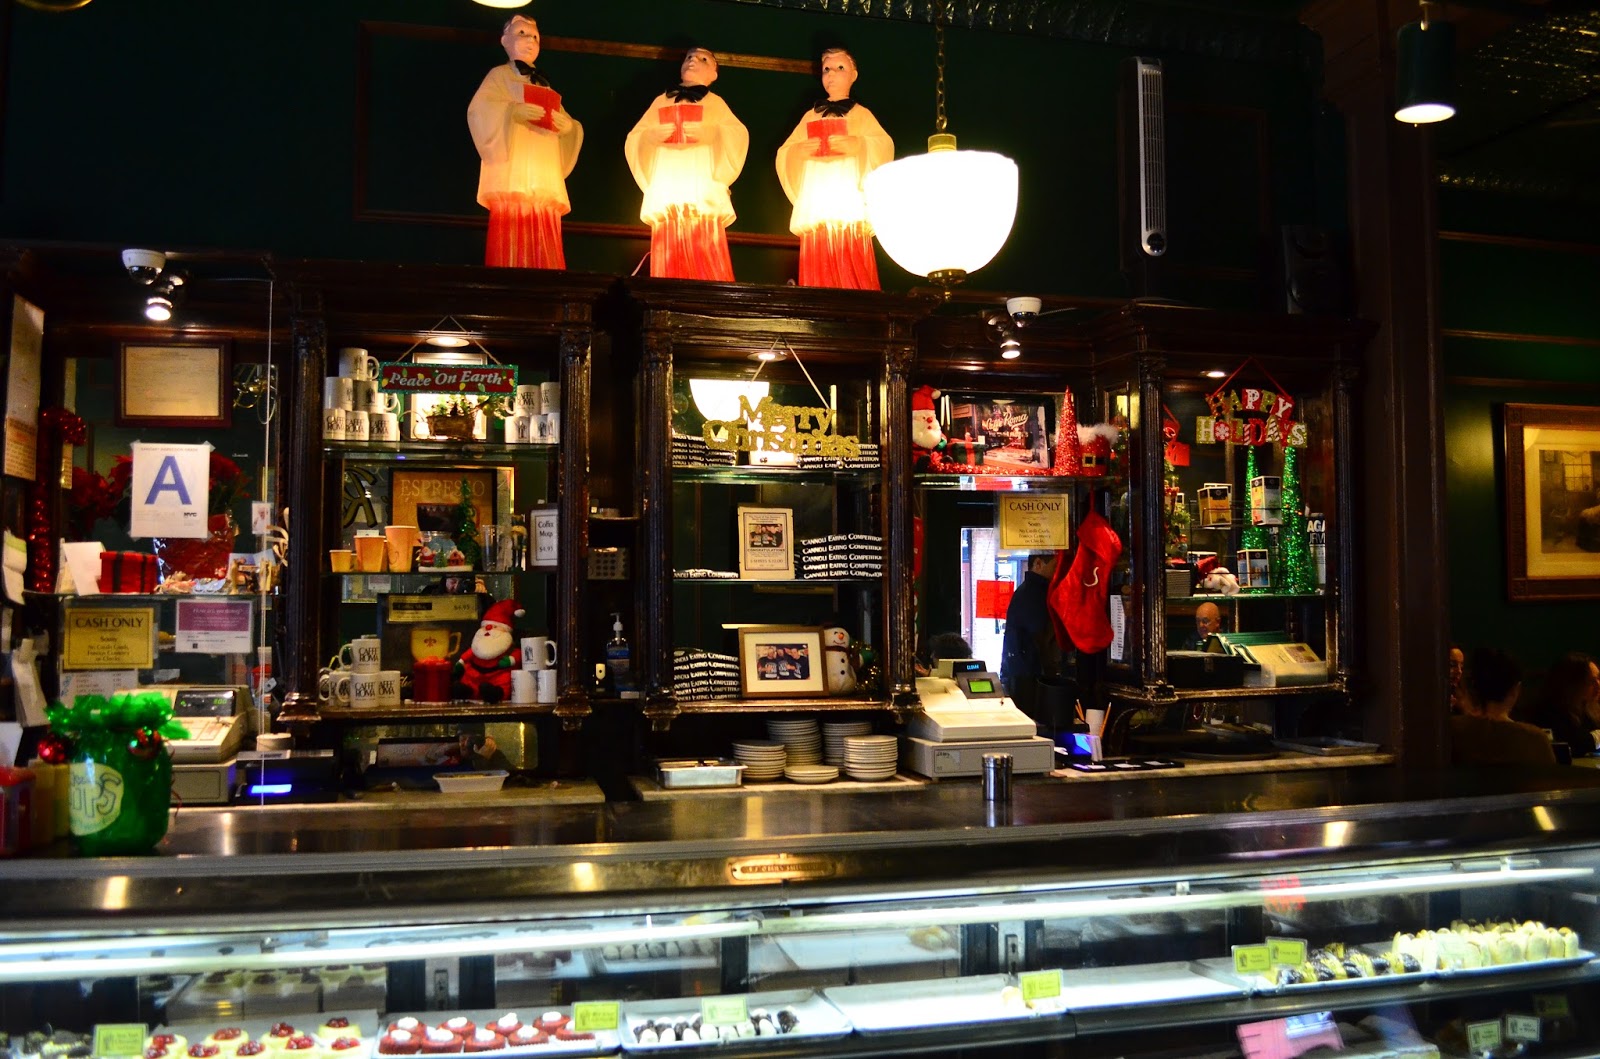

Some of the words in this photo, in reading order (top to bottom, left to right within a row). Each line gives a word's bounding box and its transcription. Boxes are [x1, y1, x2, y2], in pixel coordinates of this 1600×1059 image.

[389, 372, 432, 386] Peace
[435, 372, 457, 385] On
[460, 370, 502, 385] Earth
[1205, 388, 1294, 418] HAPPY
[738, 395, 835, 437] Merry
[1003, 406, 1029, 430] Roma
[702, 419, 861, 458] Christmas
[144, 456, 192, 505] A
[401, 480, 485, 497] ESPRESSO
[1009, 502, 1034, 511] CASH
[1036, 502, 1061, 511] ONLY
[76, 618, 108, 628] CASH
[112, 618, 143, 628] ONLY
